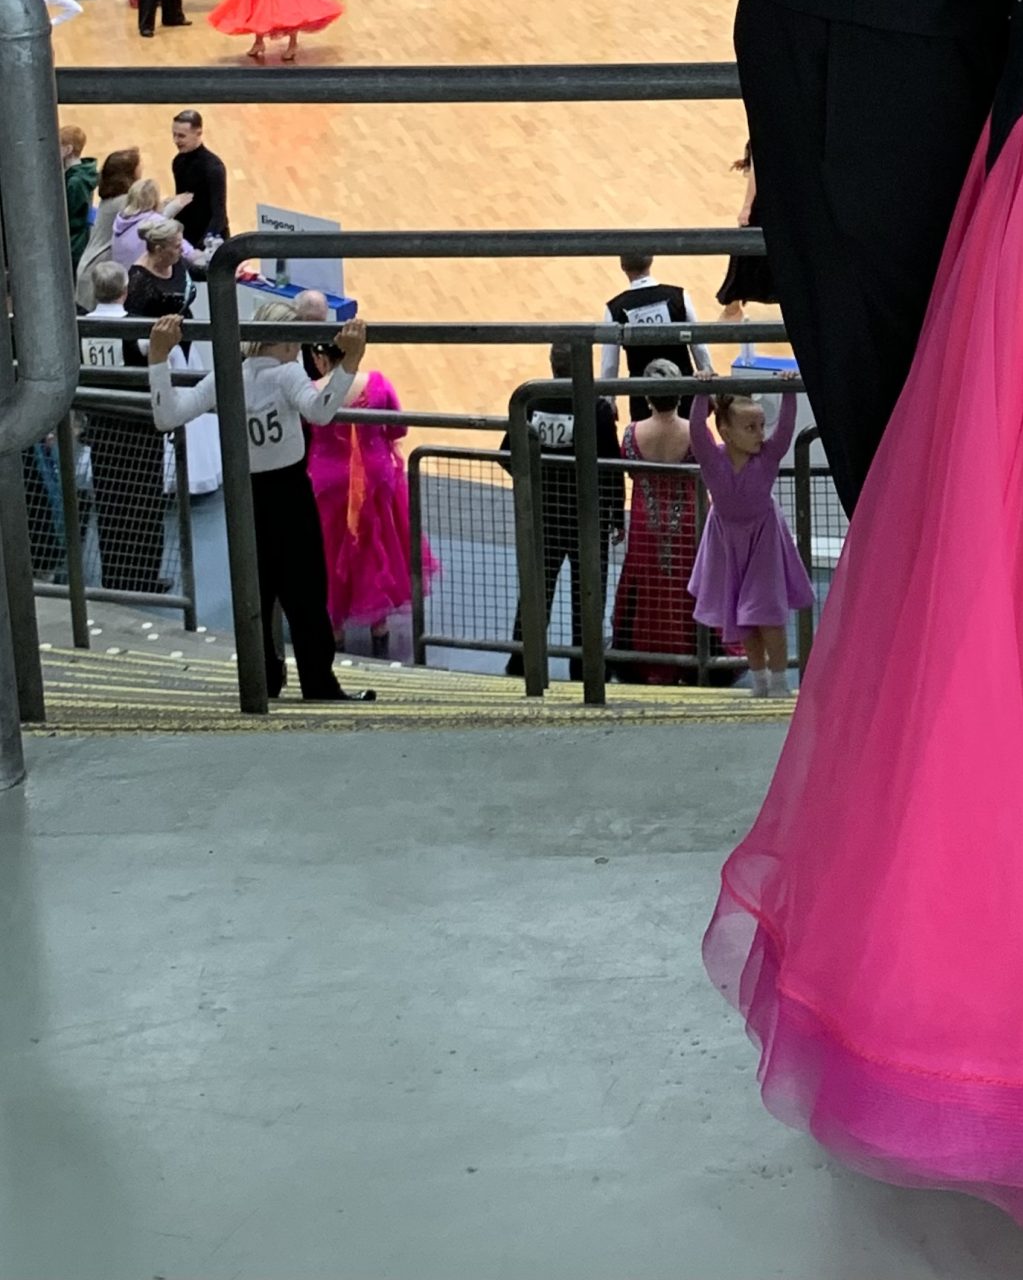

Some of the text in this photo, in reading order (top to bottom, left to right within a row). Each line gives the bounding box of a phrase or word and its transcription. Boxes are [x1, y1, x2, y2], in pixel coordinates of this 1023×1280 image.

[261, 214, 295, 232] Eingang
[89, 345, 115, 366] 611
[539, 421, 566, 444] 612
